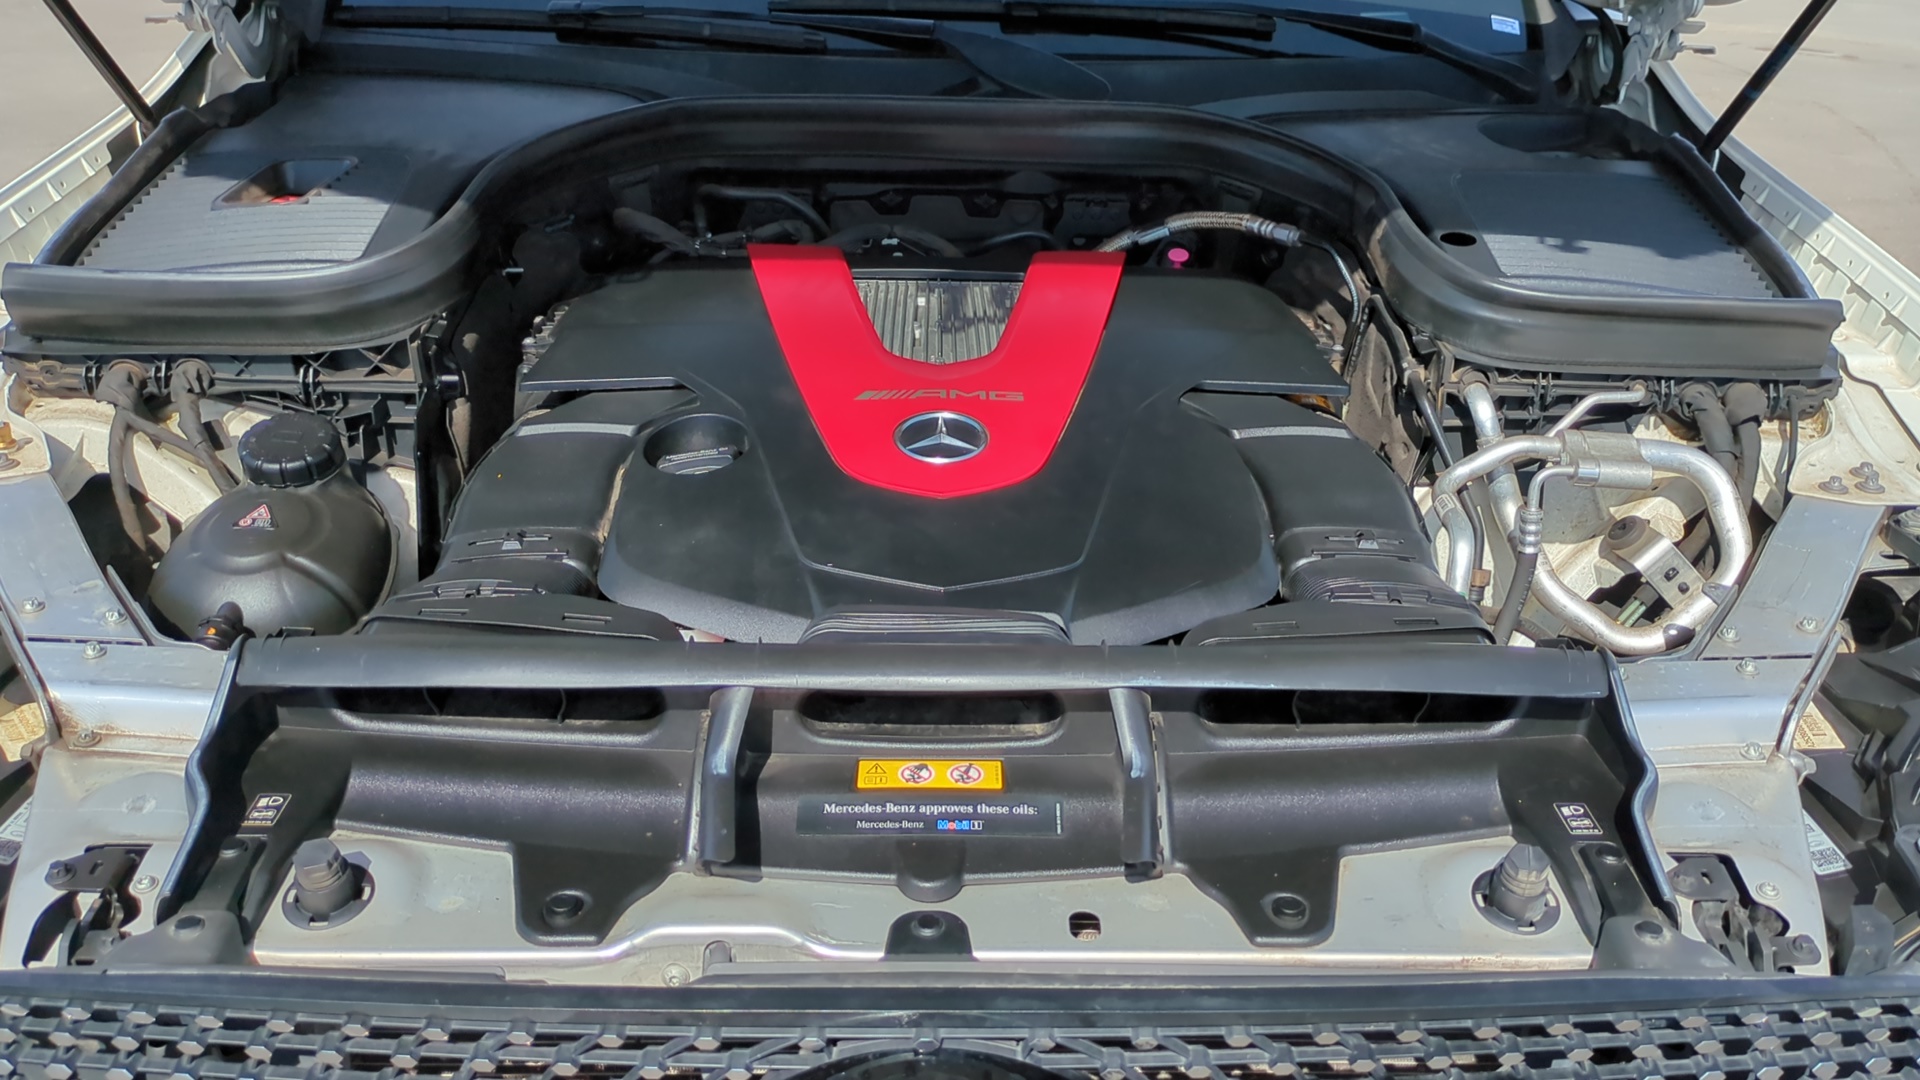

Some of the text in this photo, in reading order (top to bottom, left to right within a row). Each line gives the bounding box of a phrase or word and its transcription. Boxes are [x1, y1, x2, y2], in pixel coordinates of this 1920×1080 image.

[910, 389, 1024, 401] AMG
[823, 802, 1038, 815] Mercedes-Benz approves these oils:
[856, 820, 925, 829] Mercedes-Benz
[937, 820, 970, 830] Mobil
